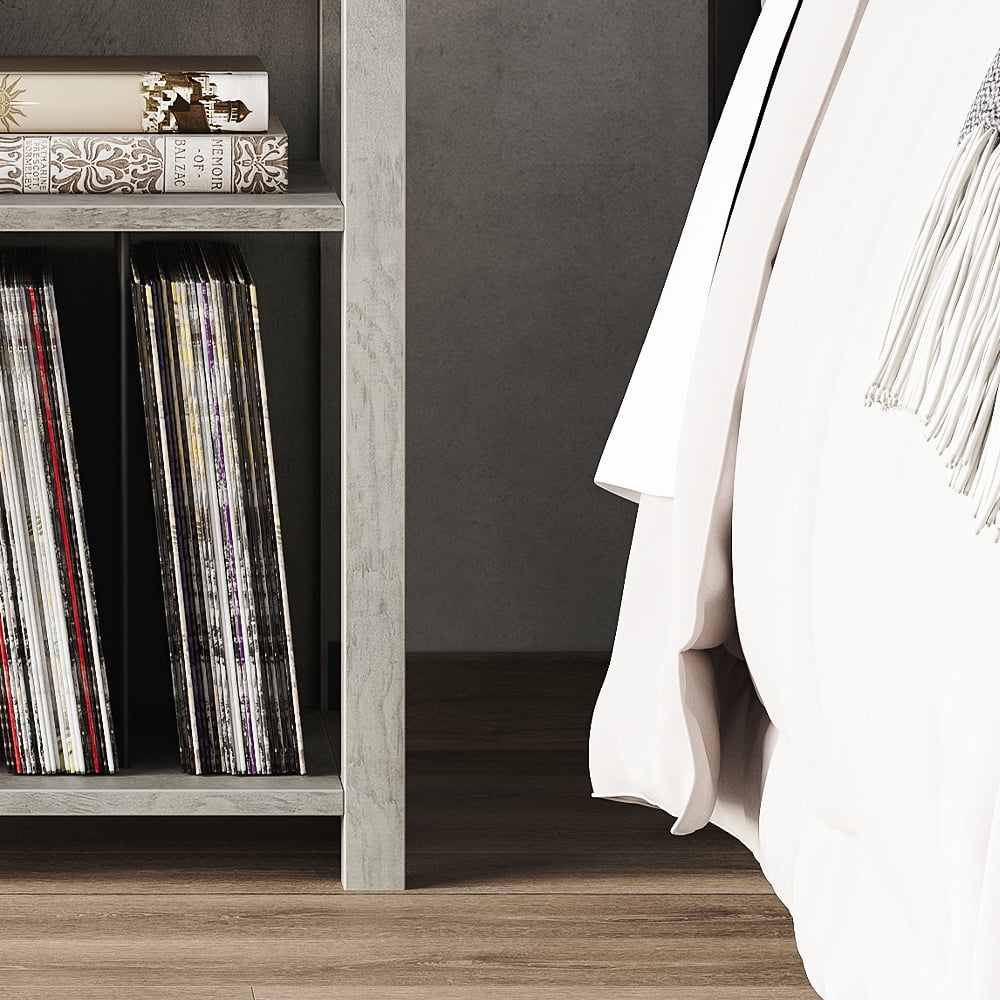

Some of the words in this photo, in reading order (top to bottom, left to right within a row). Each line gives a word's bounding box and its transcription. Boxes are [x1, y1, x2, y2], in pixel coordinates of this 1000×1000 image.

[24, 140, 32, 190] ORMELEY
[174, 139, 186, 187] BALZAC
[211, 139, 223, 190] MEMOIR
